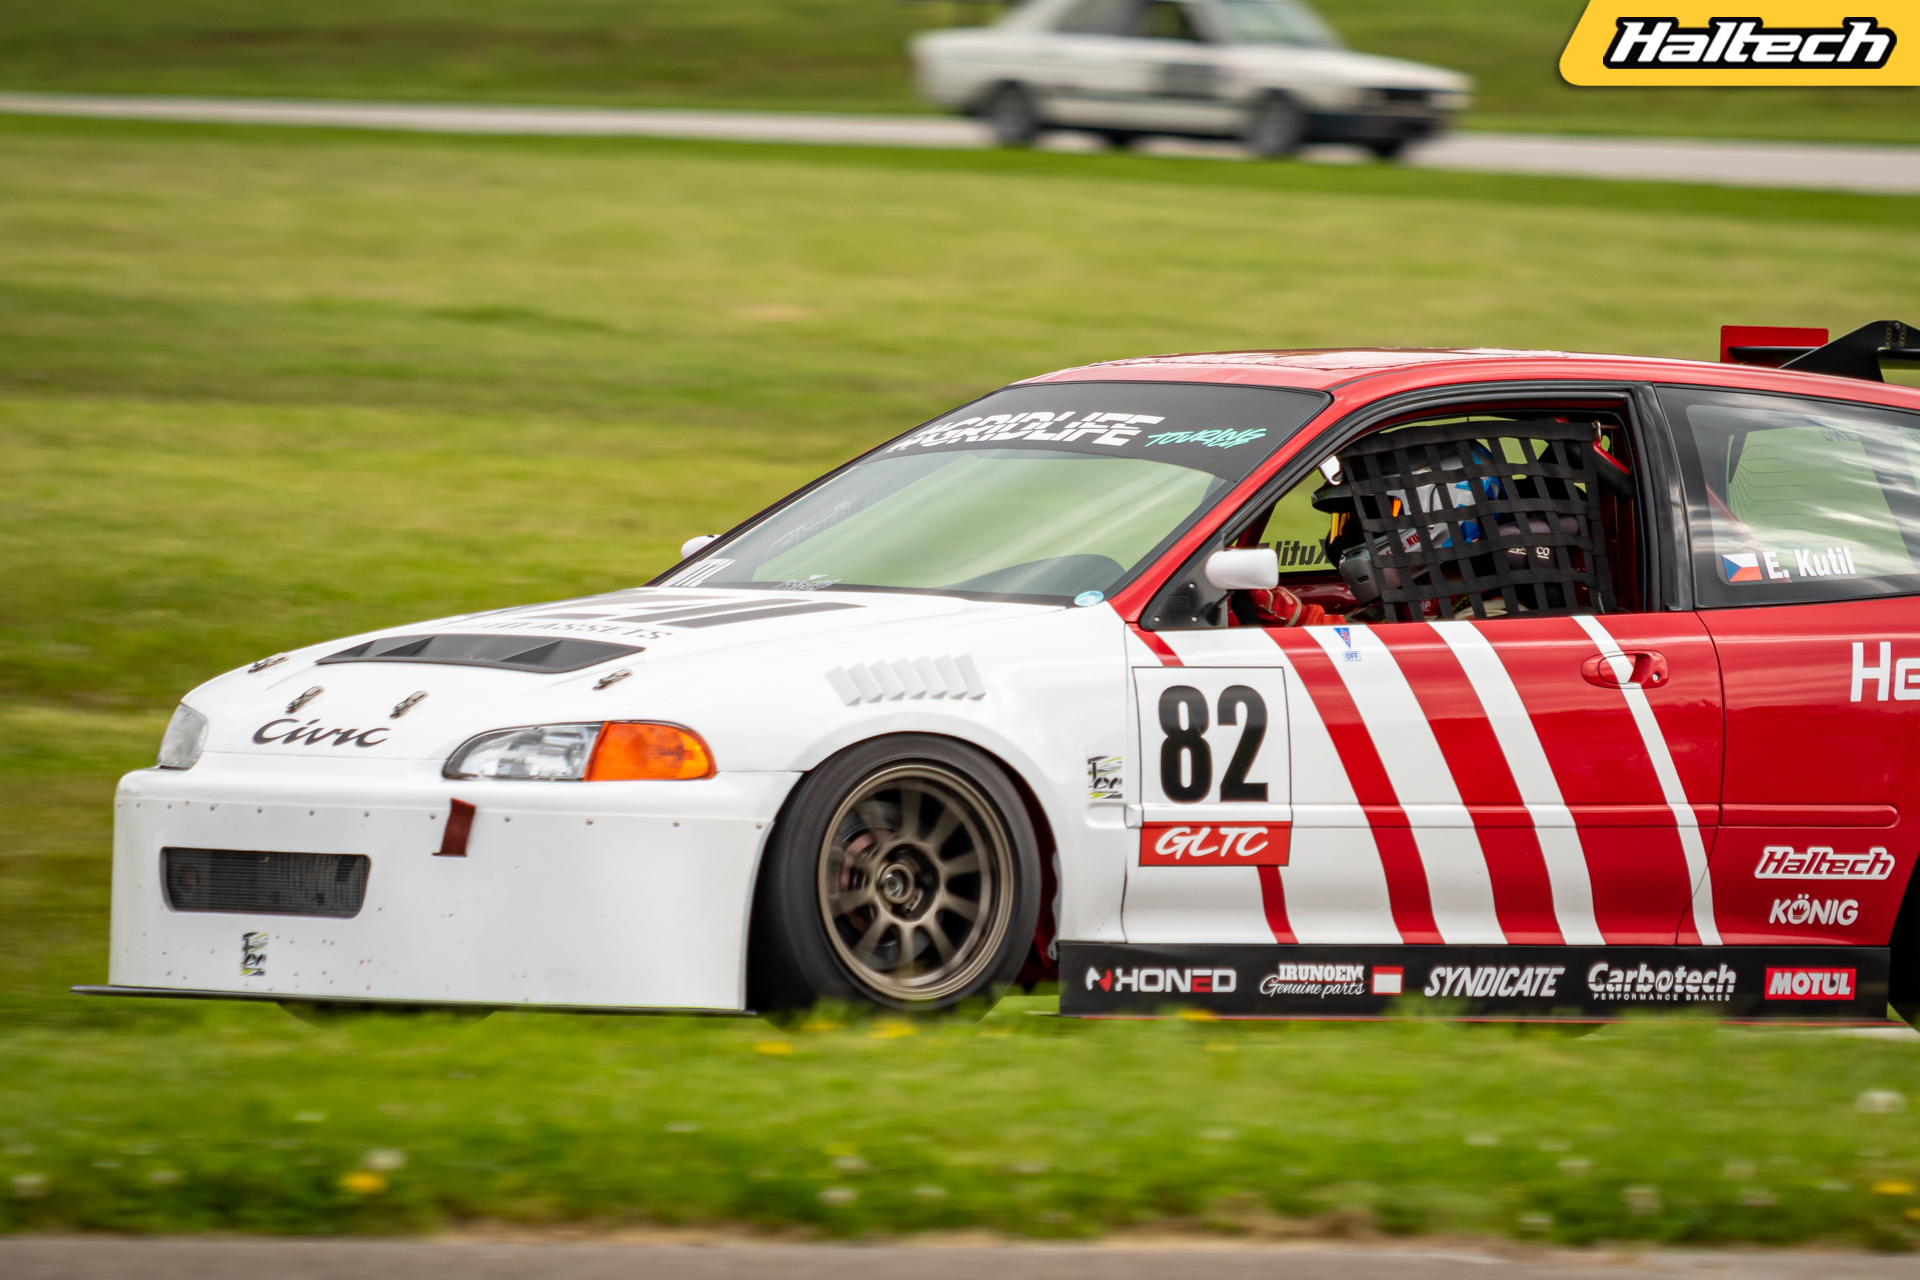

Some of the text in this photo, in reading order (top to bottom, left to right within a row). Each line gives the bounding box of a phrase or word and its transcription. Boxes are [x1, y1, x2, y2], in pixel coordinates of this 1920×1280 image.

[1144, 428, 1267, 447] TOURING
[1762, 547, 1857, 580] E. Kutil
[1345, 652, 1359, 660] OFF
[1850, 641, 1920, 702] He
[253, 718, 391, 748] Civic
[1158, 684, 1269, 804] 82
[1155, 826, 1268, 861] GLTC
[1757, 849, 1893, 878] Haltech
[1769, 894, 1859, 926] KÖNIG
[1115, 967, 1237, 994] HONED
[1259, 975, 1366, 999] Genuine parts
[1424, 966, 1566, 998] SYNDICATE
[1588, 963, 1737, 993] Carbotech
[1769, 971, 1852, 997] MOTUL
[1593, 993, 1730, 1001] PERFORMANCE BRAKES
